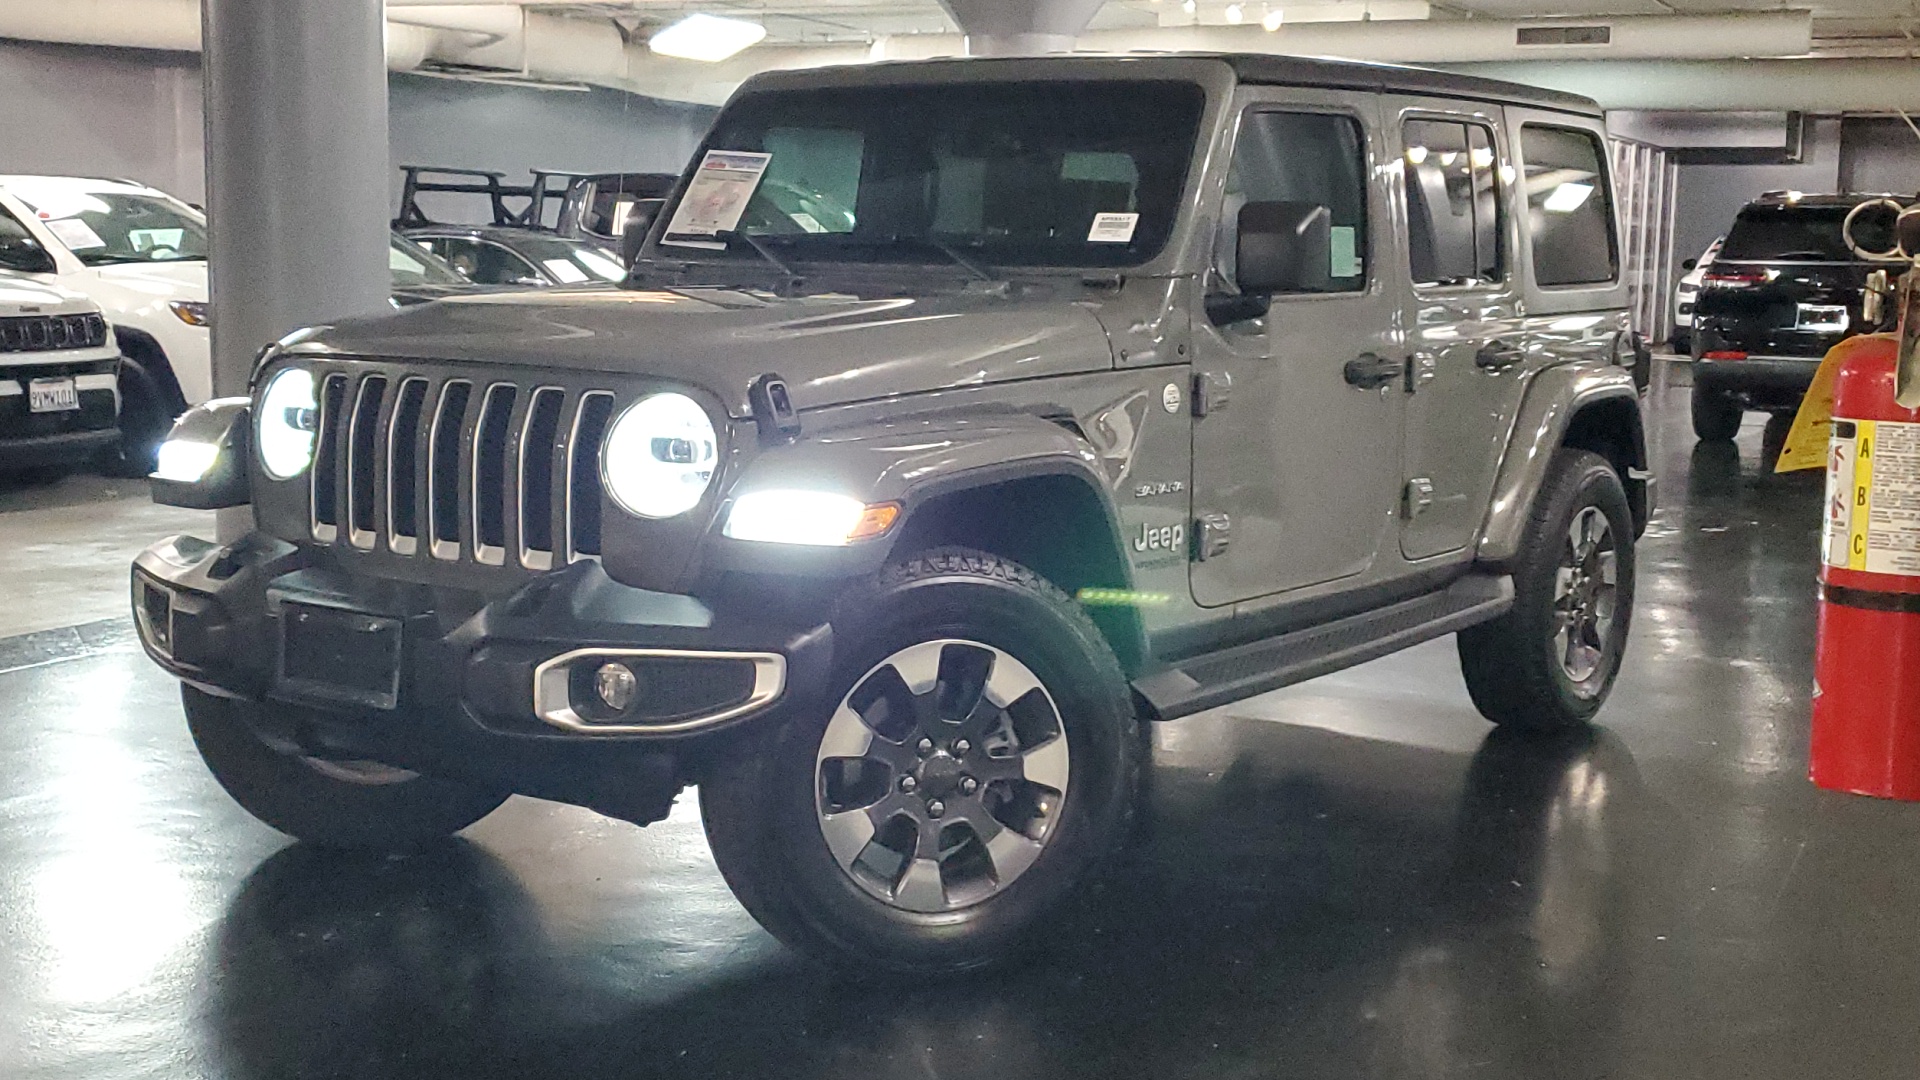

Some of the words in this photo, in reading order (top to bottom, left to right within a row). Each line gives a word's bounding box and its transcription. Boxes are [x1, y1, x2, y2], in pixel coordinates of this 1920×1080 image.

[1859, 437, 1870, 459] A
[1856, 486, 1866, 506] B
[1134, 522, 1184, 552] Jeep
[1853, 534, 1864, 555] C
